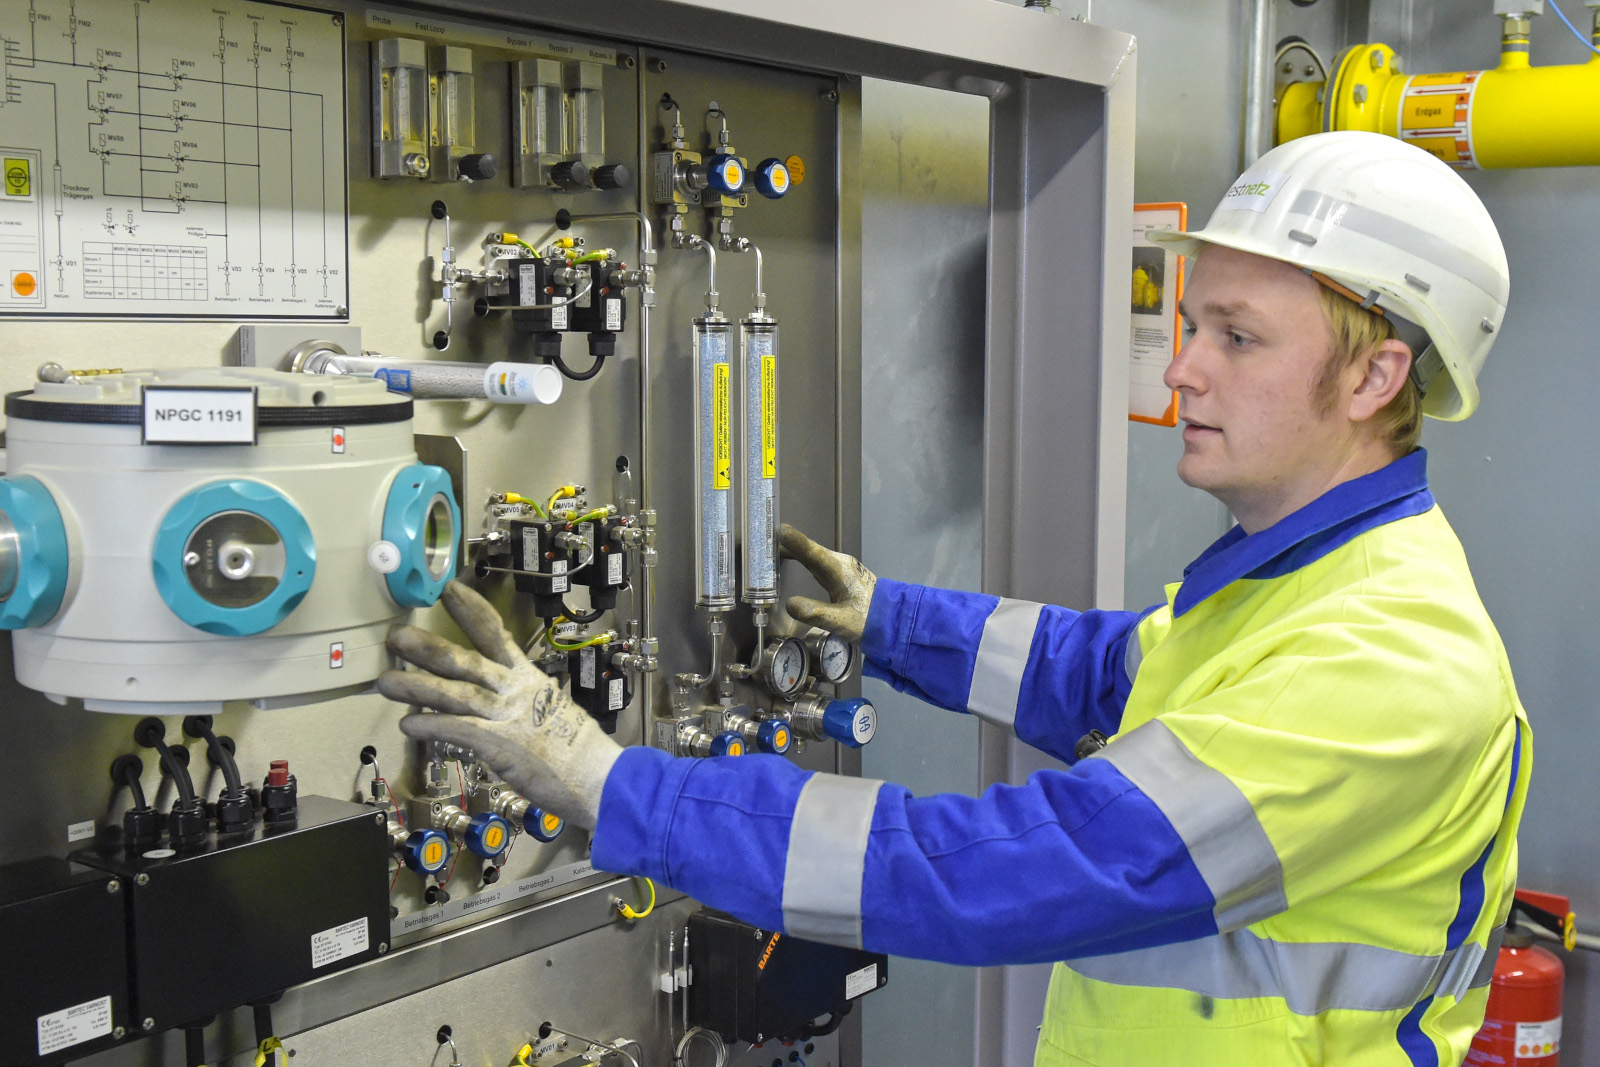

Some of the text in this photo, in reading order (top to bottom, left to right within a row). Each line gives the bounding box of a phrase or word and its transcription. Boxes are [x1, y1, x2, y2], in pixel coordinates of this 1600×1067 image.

[373, 15, 391, 25] Probe
[416, 22, 445, 34] Fast Loop
[507, 37, 527, 46] Bypass
[549, 44, 568, 53] Bypass
[589, 50, 607, 59] Bypass
[1416, 108, 1442, 117] Erdgas
[63, 191, 94, 200] Trägergas
[155, 409, 242, 422] NPGC 1191
[573, 866, 592, 875] Kalibrie
[519, 879, 550, 892] Betriebsgas
[463, 896, 496, 909] Betriebsgas
[404, 912, 440, 928] Betriebsgas
[758, 932, 780, 970] BARTE
[541, 1043, 554, 1053] MV01
